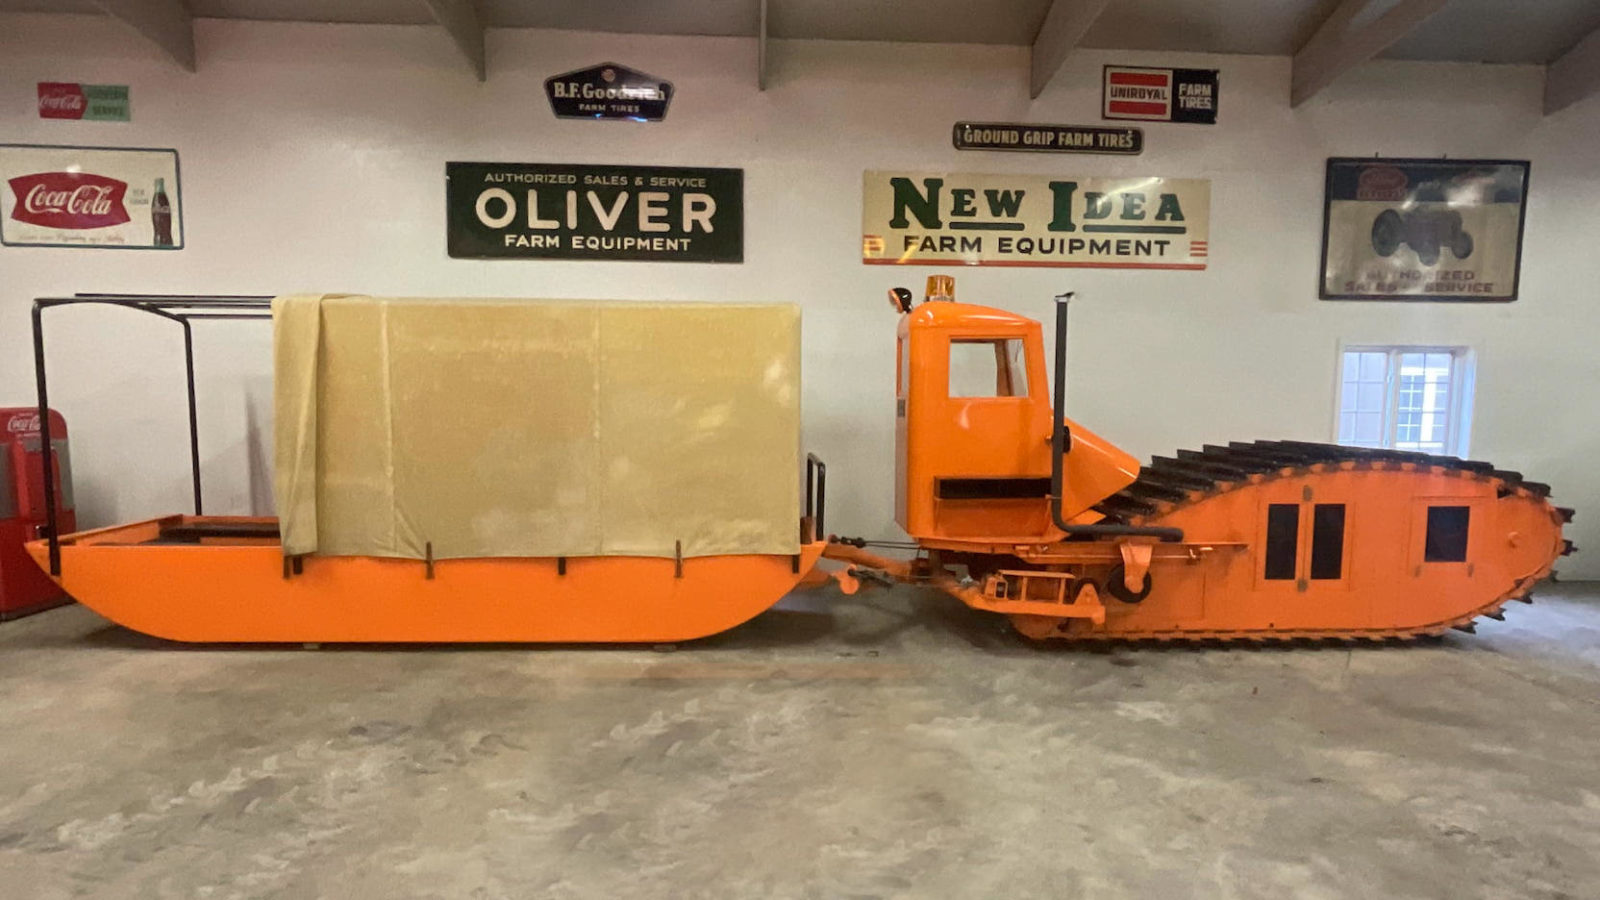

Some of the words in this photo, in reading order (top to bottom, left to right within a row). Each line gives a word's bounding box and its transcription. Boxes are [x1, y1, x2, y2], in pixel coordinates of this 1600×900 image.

[1110, 87, 1168, 100] UNIROYAL
[1179, 83, 1212, 96] FARM
[579, 103, 606, 111] FARM
[611, 104, 640, 112] TIRES
[1179, 96, 1212, 109] TIRES
[964, 129, 1019, 144] GROUND
[1023, 131, 1055, 146] GRIP
[1058, 132, 1094, 147] FARM
[1098, 134, 1134, 148] TIRES
[484, 172, 577, 184] AUTHORIZED
[584, 174, 628, 186] SALES
[634, 176, 644, 186] &
[650, 176, 707, 188] SERVICE
[24, 183, 114, 215] Coca-Cola
[475, 187, 717, 234] OLIVER
[504, 234, 560, 249] FARM
[572, 236, 692, 251] EQUIPMENT
[904, 235, 982, 254] FARM
[998, 236, 1171, 257] EQUIPMENT
[1425, 282, 1494, 293] SERVICE
